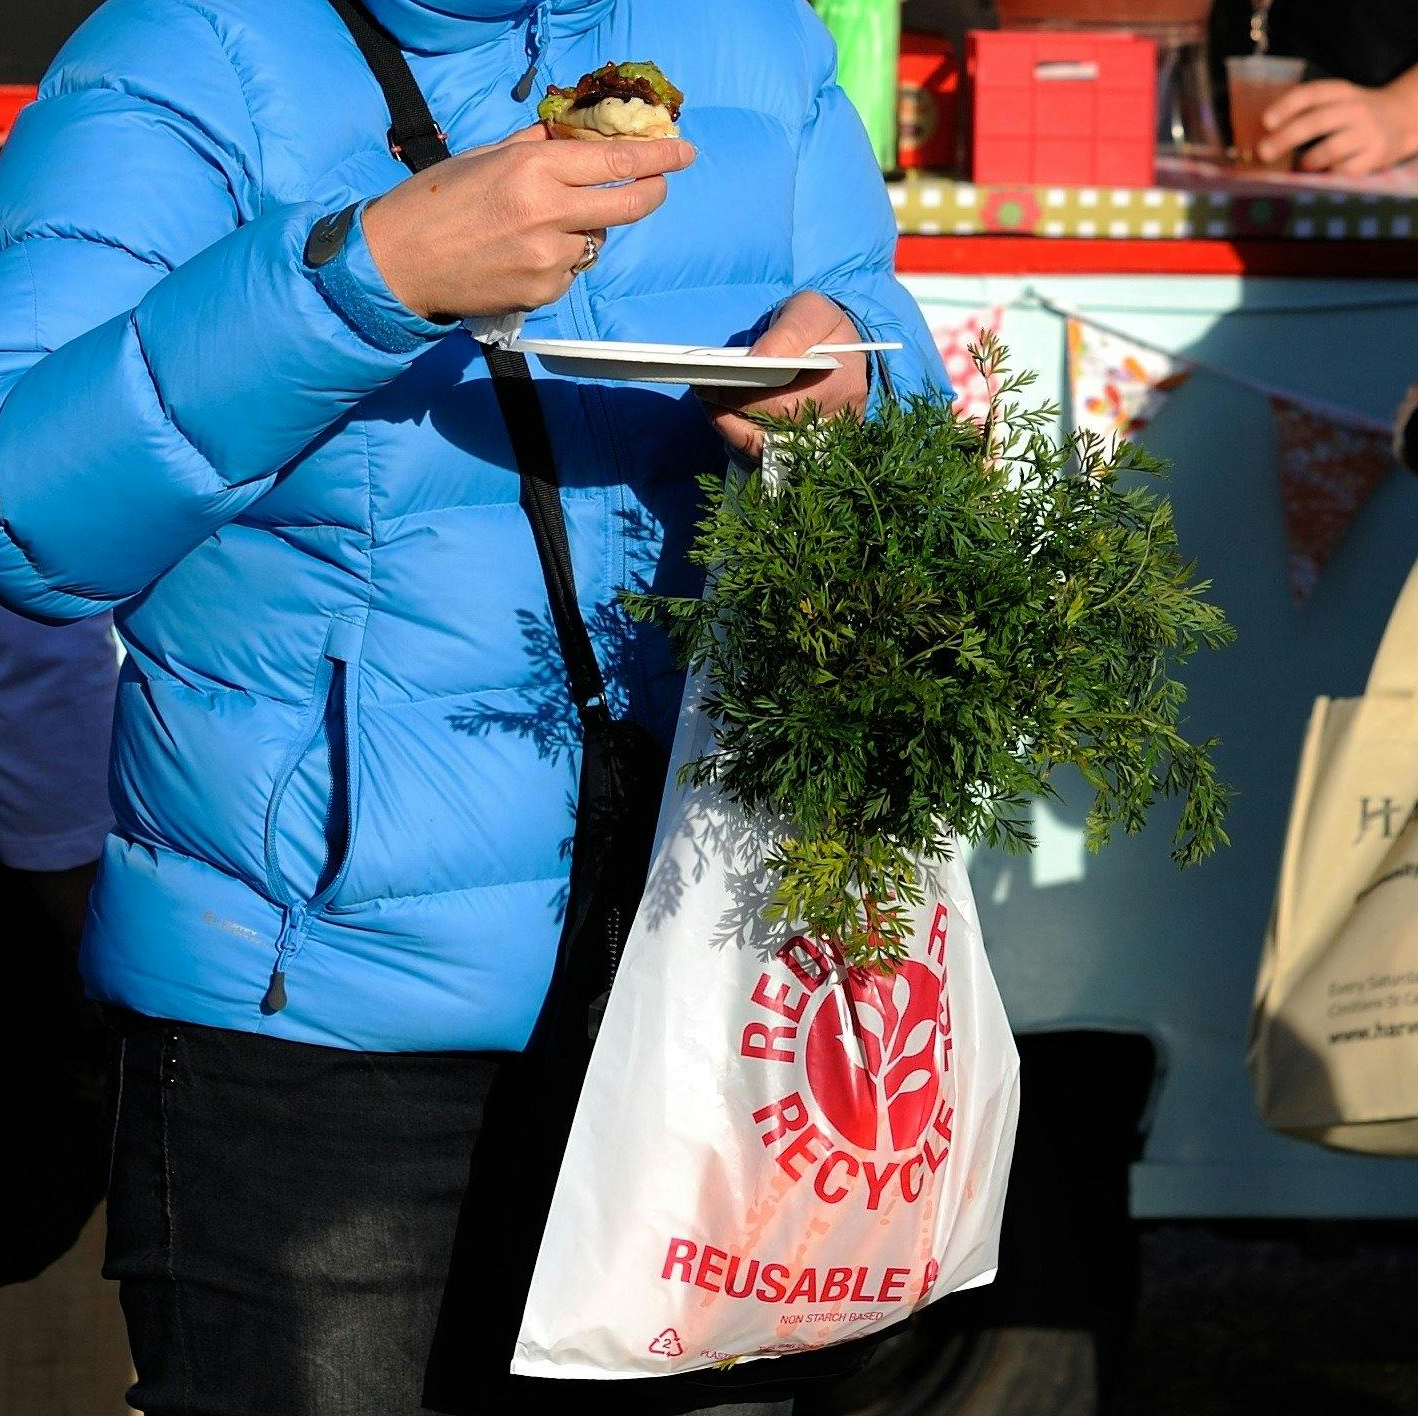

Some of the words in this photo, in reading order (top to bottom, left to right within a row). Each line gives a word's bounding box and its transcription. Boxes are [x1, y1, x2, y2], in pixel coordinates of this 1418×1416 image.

[752, 1091, 955, 1211] RECYCLE
[660, 1237, 911, 1305] REUSABLE
[779, 1313, 804, 1324] NON
[805, 1312, 847, 1323] STARCH
[848, 1311, 884, 1322] BASED
